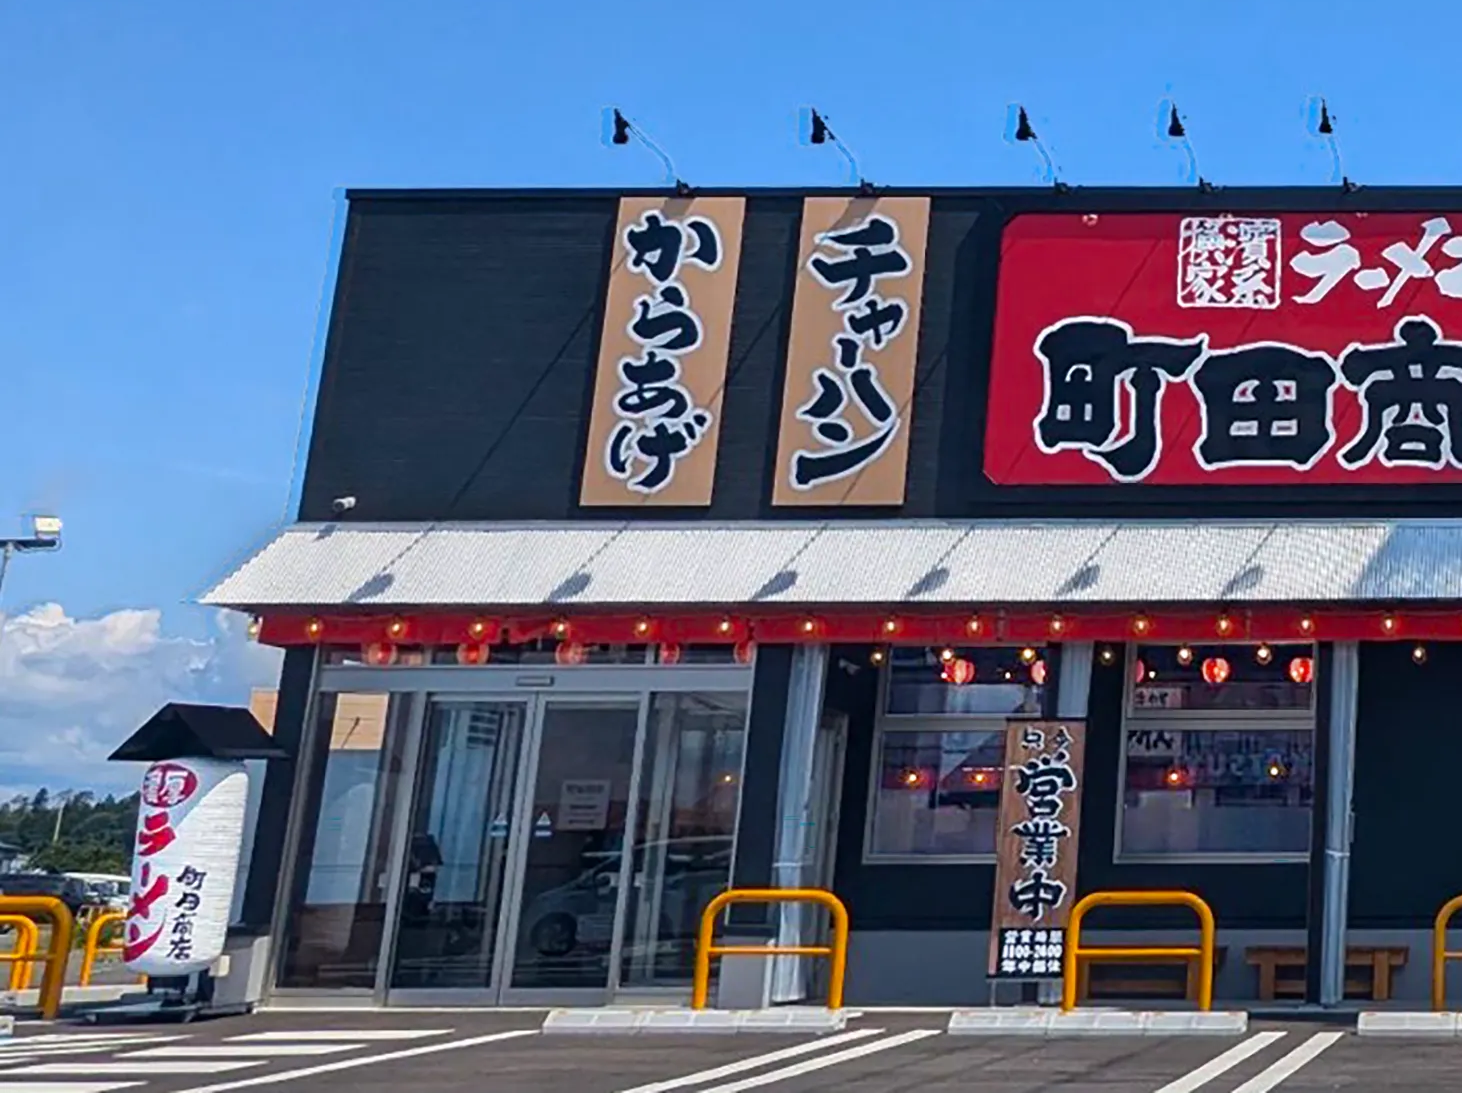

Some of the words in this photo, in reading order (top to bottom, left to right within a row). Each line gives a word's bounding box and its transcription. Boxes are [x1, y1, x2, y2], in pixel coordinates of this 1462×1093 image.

[605, 209, 722, 493] からあげ
[789, 214, 912, 490] チャーハン
[123, 811, 176, 962] ラーメン
[1010, 750, 1077, 921] 営業中
